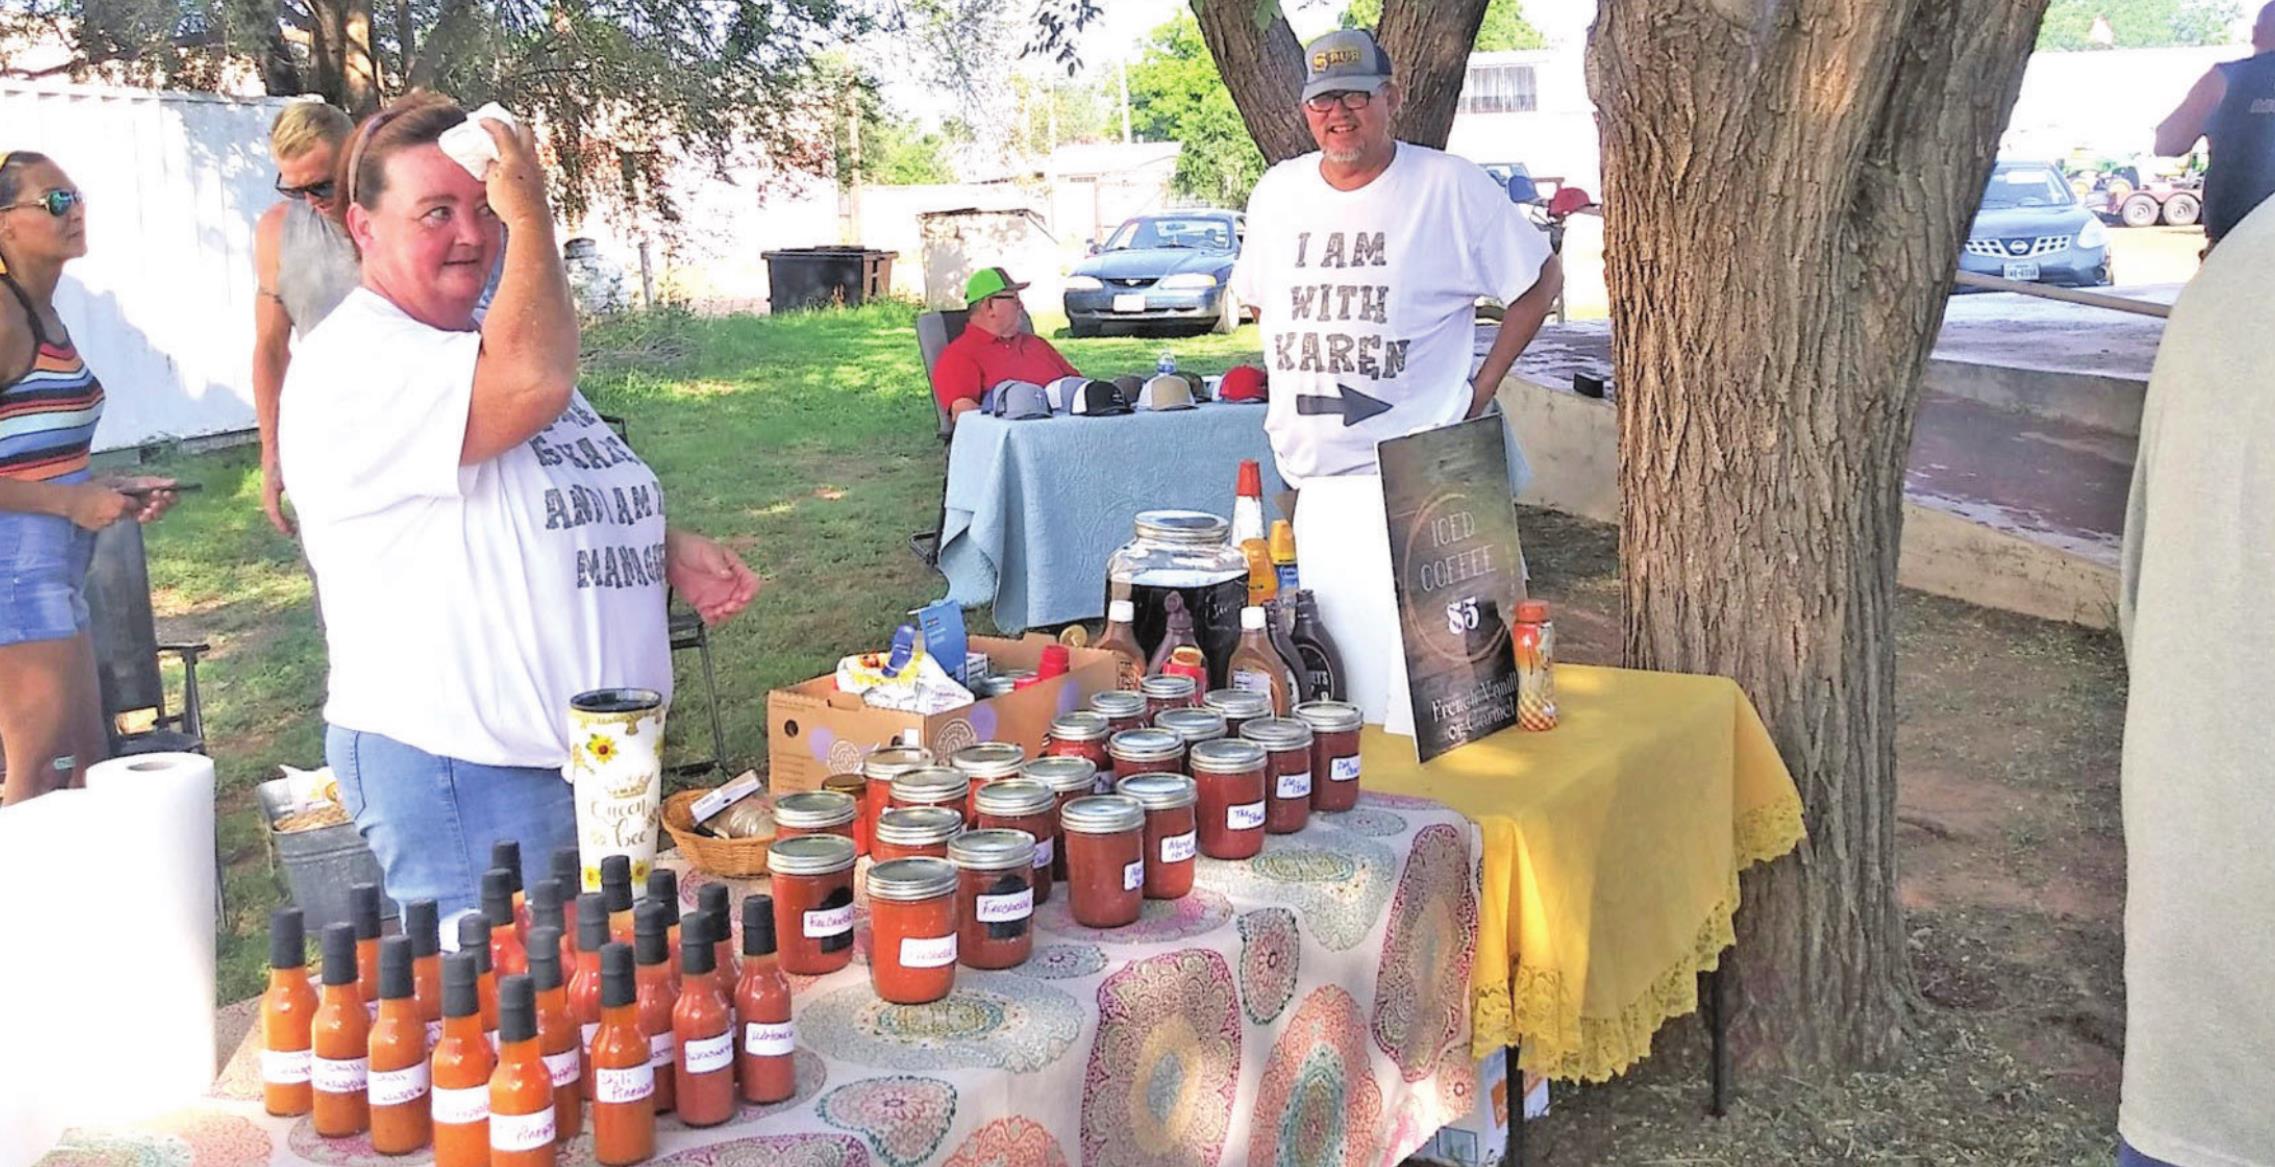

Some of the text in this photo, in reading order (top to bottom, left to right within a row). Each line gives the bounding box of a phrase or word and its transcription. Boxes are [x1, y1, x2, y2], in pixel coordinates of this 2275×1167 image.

[1295, 231, 1388, 268] I AM
[1291, 284, 1390, 324] WITH
[1274, 331, 1411, 381] KAREN
[1431, 511, 1476, 548] ICED
[576, 543, 665, 589] MANAGE
[1420, 544, 1497, 593] COFFEE
